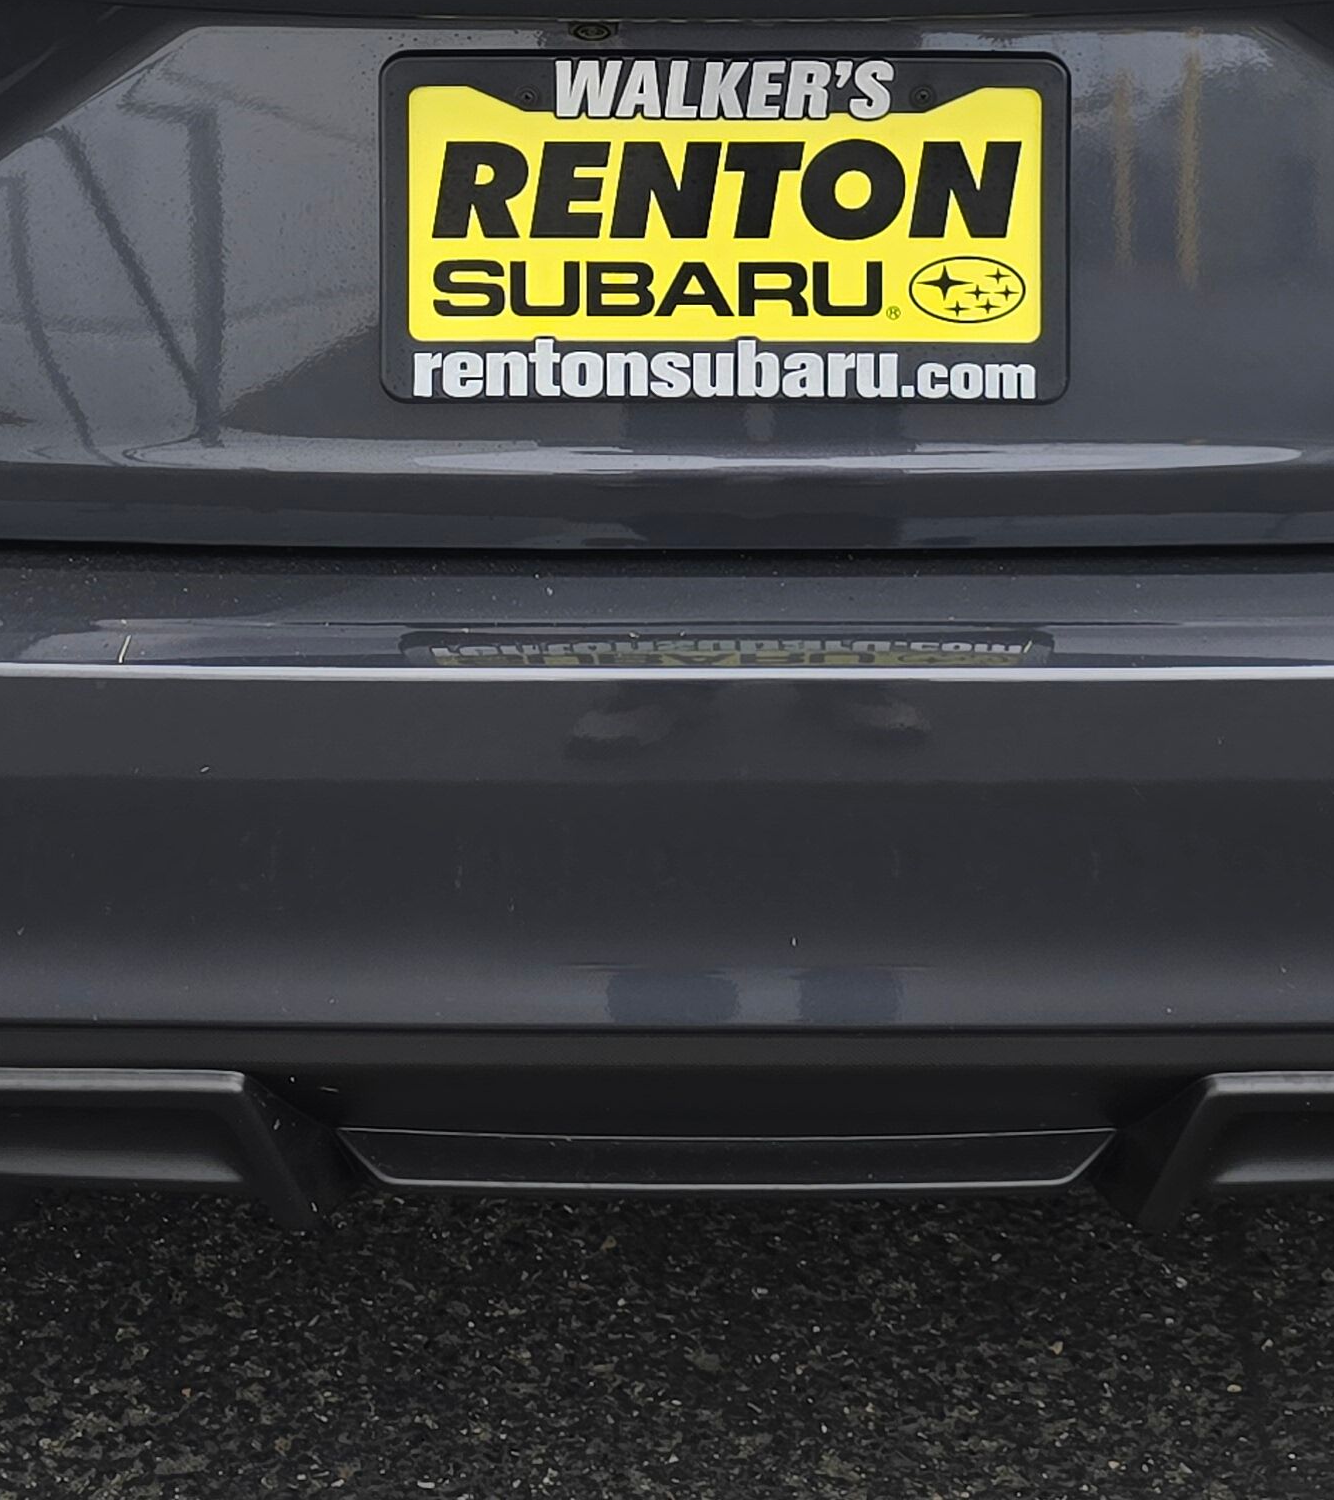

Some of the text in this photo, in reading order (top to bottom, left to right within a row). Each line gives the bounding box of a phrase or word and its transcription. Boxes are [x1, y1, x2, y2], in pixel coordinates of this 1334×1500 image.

[555, 59, 895, 120] WALKER'S
[431, 139, 1023, 240] RENTON
[432, 260, 883, 318] SUBARU
[413, 338, 1036, 399] rentonsubaru.com
